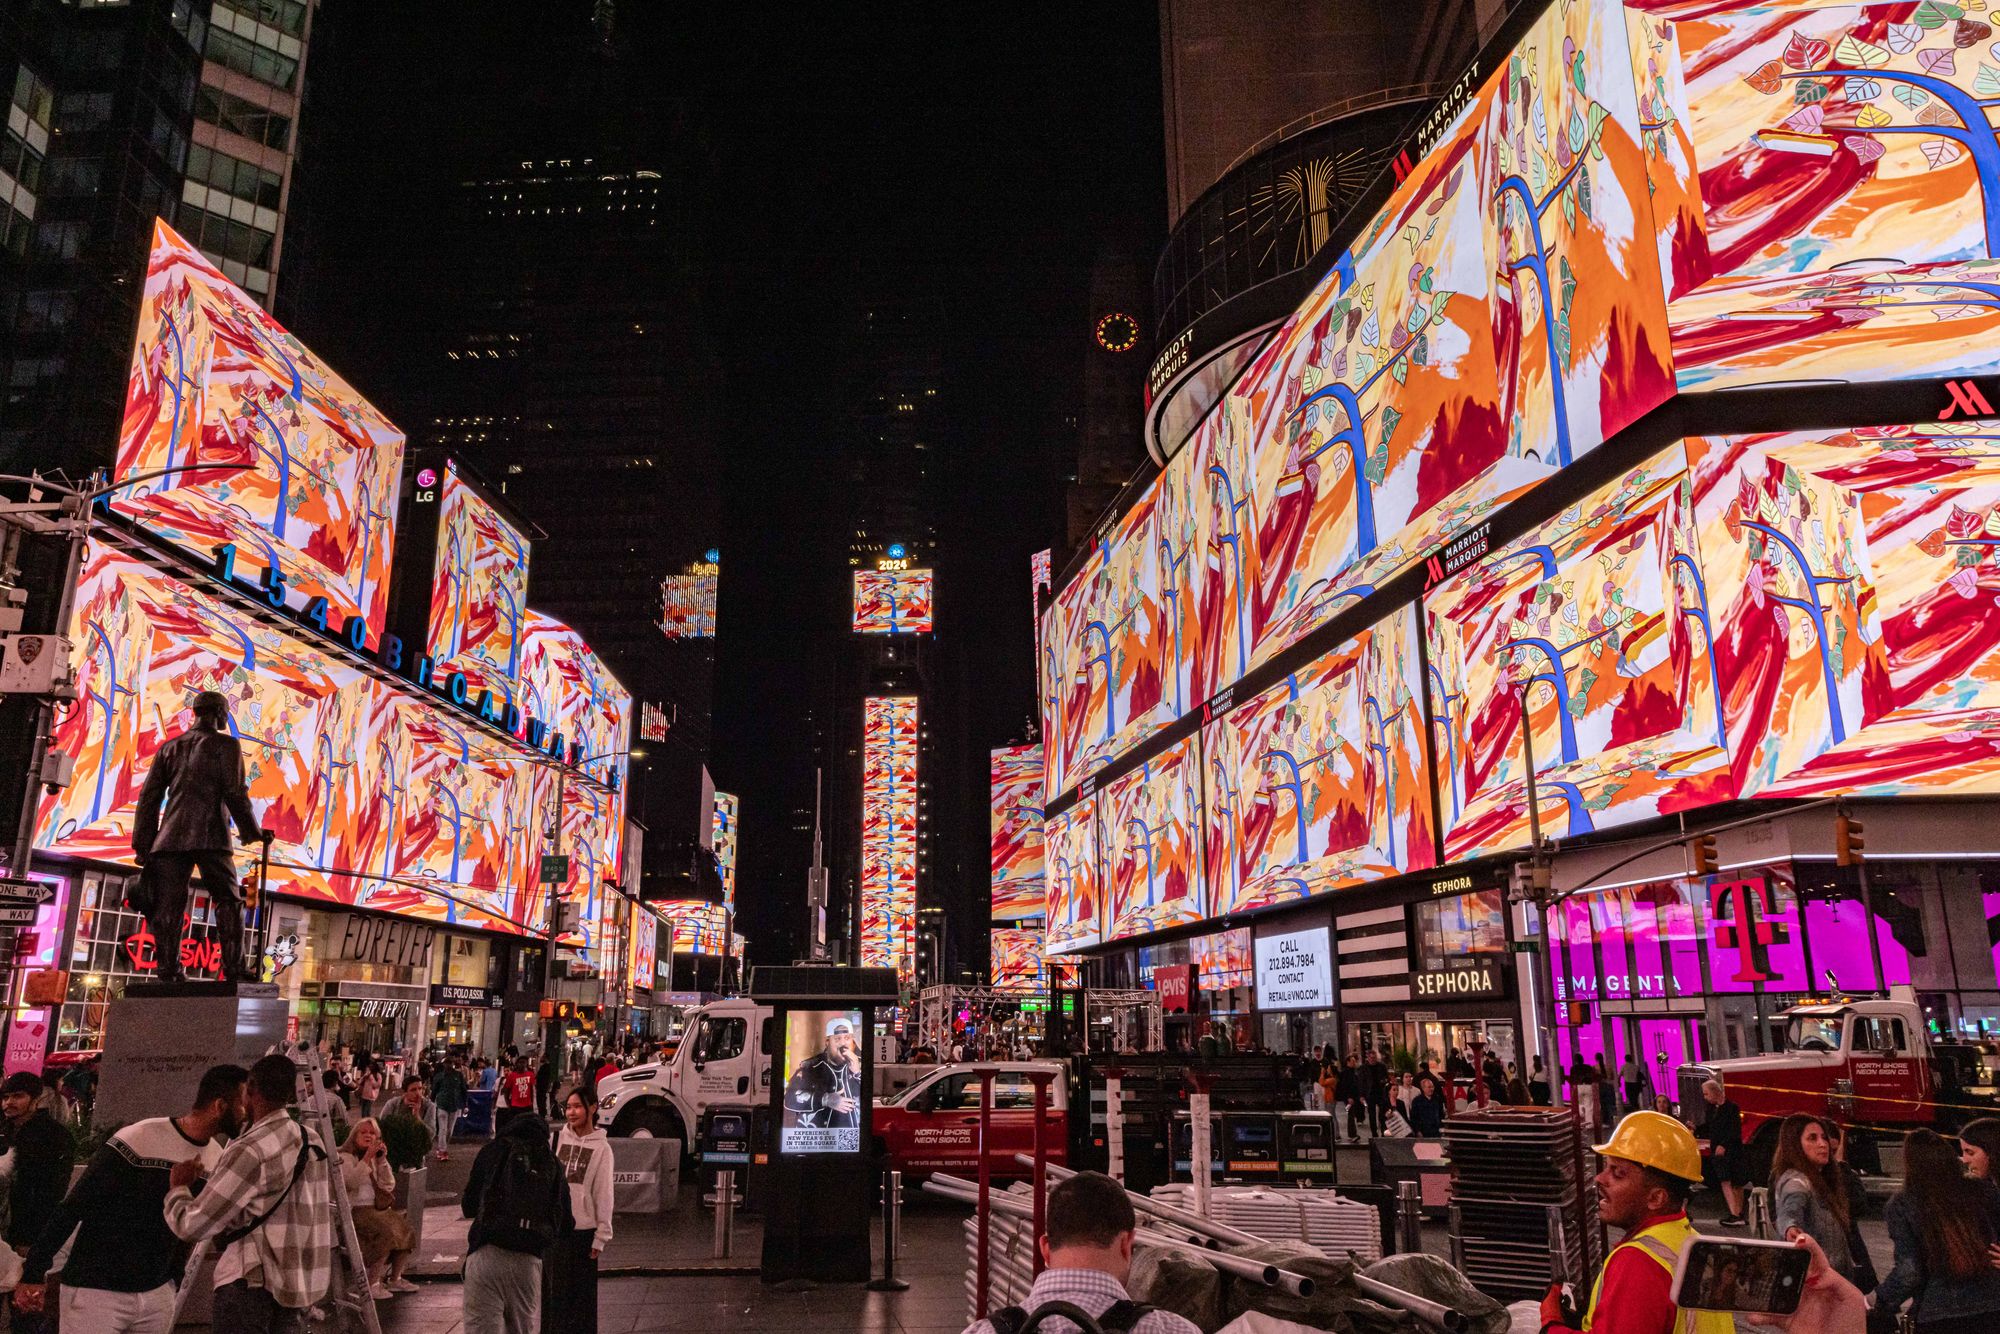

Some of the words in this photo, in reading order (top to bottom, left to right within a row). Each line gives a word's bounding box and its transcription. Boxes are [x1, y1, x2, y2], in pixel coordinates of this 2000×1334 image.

[1418, 61, 1479, 145] MARRIOTT
[1151, 328, 1193, 381] MARRIOTT
[1152, 351, 1187, 397] MARQUIS
[416, 491, 434, 502] LG
[1445, 522, 1491, 559] MARRIOTT
[1447, 540, 1487, 573] MARQUIS
[879, 559, 908, 570] 2024
[0, 885, 18, 895] ONE
[26, 887, 47, 898] WAY
[1432, 876, 1472, 895] SEPHORA
[9, 910, 30, 920] WAY
[340, 913, 434, 968] FOREVER
[1279, 940, 1299, 954] CALL
[1268, 954, 1315, 971] 212.894.7984
[1278, 972, 1304, 984] CONTACT
[1417, 970, 1493, 995] SEPHORA
[1571, 975, 1682, 991] MAGENTA
[443, 987, 452, 998] U.S.
[453, 988, 469, 999] POLO
[1268, 989, 1319, 1003] RETAIL@VNO.COM
[359, 1000, 398, 1017] FOREVER
[11, 1042, 43, 1051] BLIND
[11, 1051, 40, 1061] BOX
[515, 1076, 531, 1084] JUST
[518, 1084, 528, 1092] DO
[613, 1174, 640, 1183] UARE
